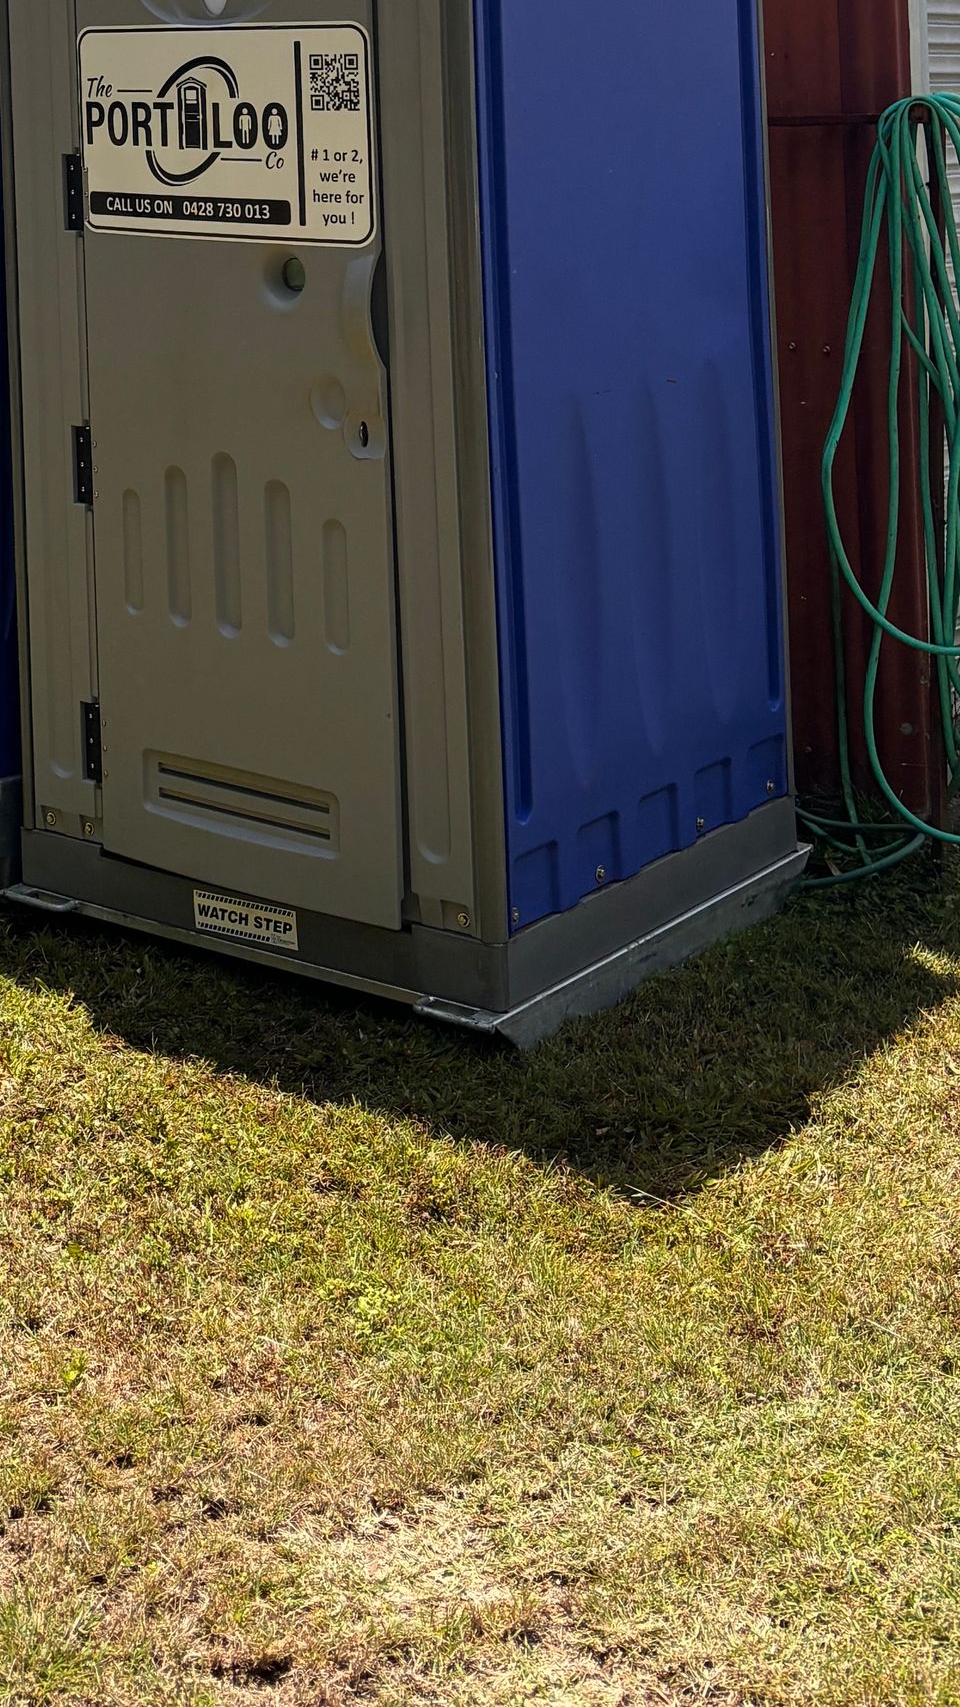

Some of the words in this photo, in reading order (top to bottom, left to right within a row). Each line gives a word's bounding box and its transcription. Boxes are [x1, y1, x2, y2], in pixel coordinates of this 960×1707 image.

[87, 75, 113, 98] The
[265, 150, 285, 170] Co
[310, 148, 319, 161] #
[322, 149, 330, 161] 1
[333, 151, 348, 162] or
[351, 149, 363, 164] 2,
[312, 189, 342, 204] here
[345, 190, 365, 204] for
[106, 196, 134, 212] CALL
[135, 198, 151, 213] US
[154, 199, 173, 215] ON
[182, 201, 214, 217] 0428
[217, 202, 241, 218] 730
[244, 203, 271, 219] 013
[322, 213, 346, 227] you
[197, 903, 249, 926] WATCH
[253, 916, 293, 935] STEP
